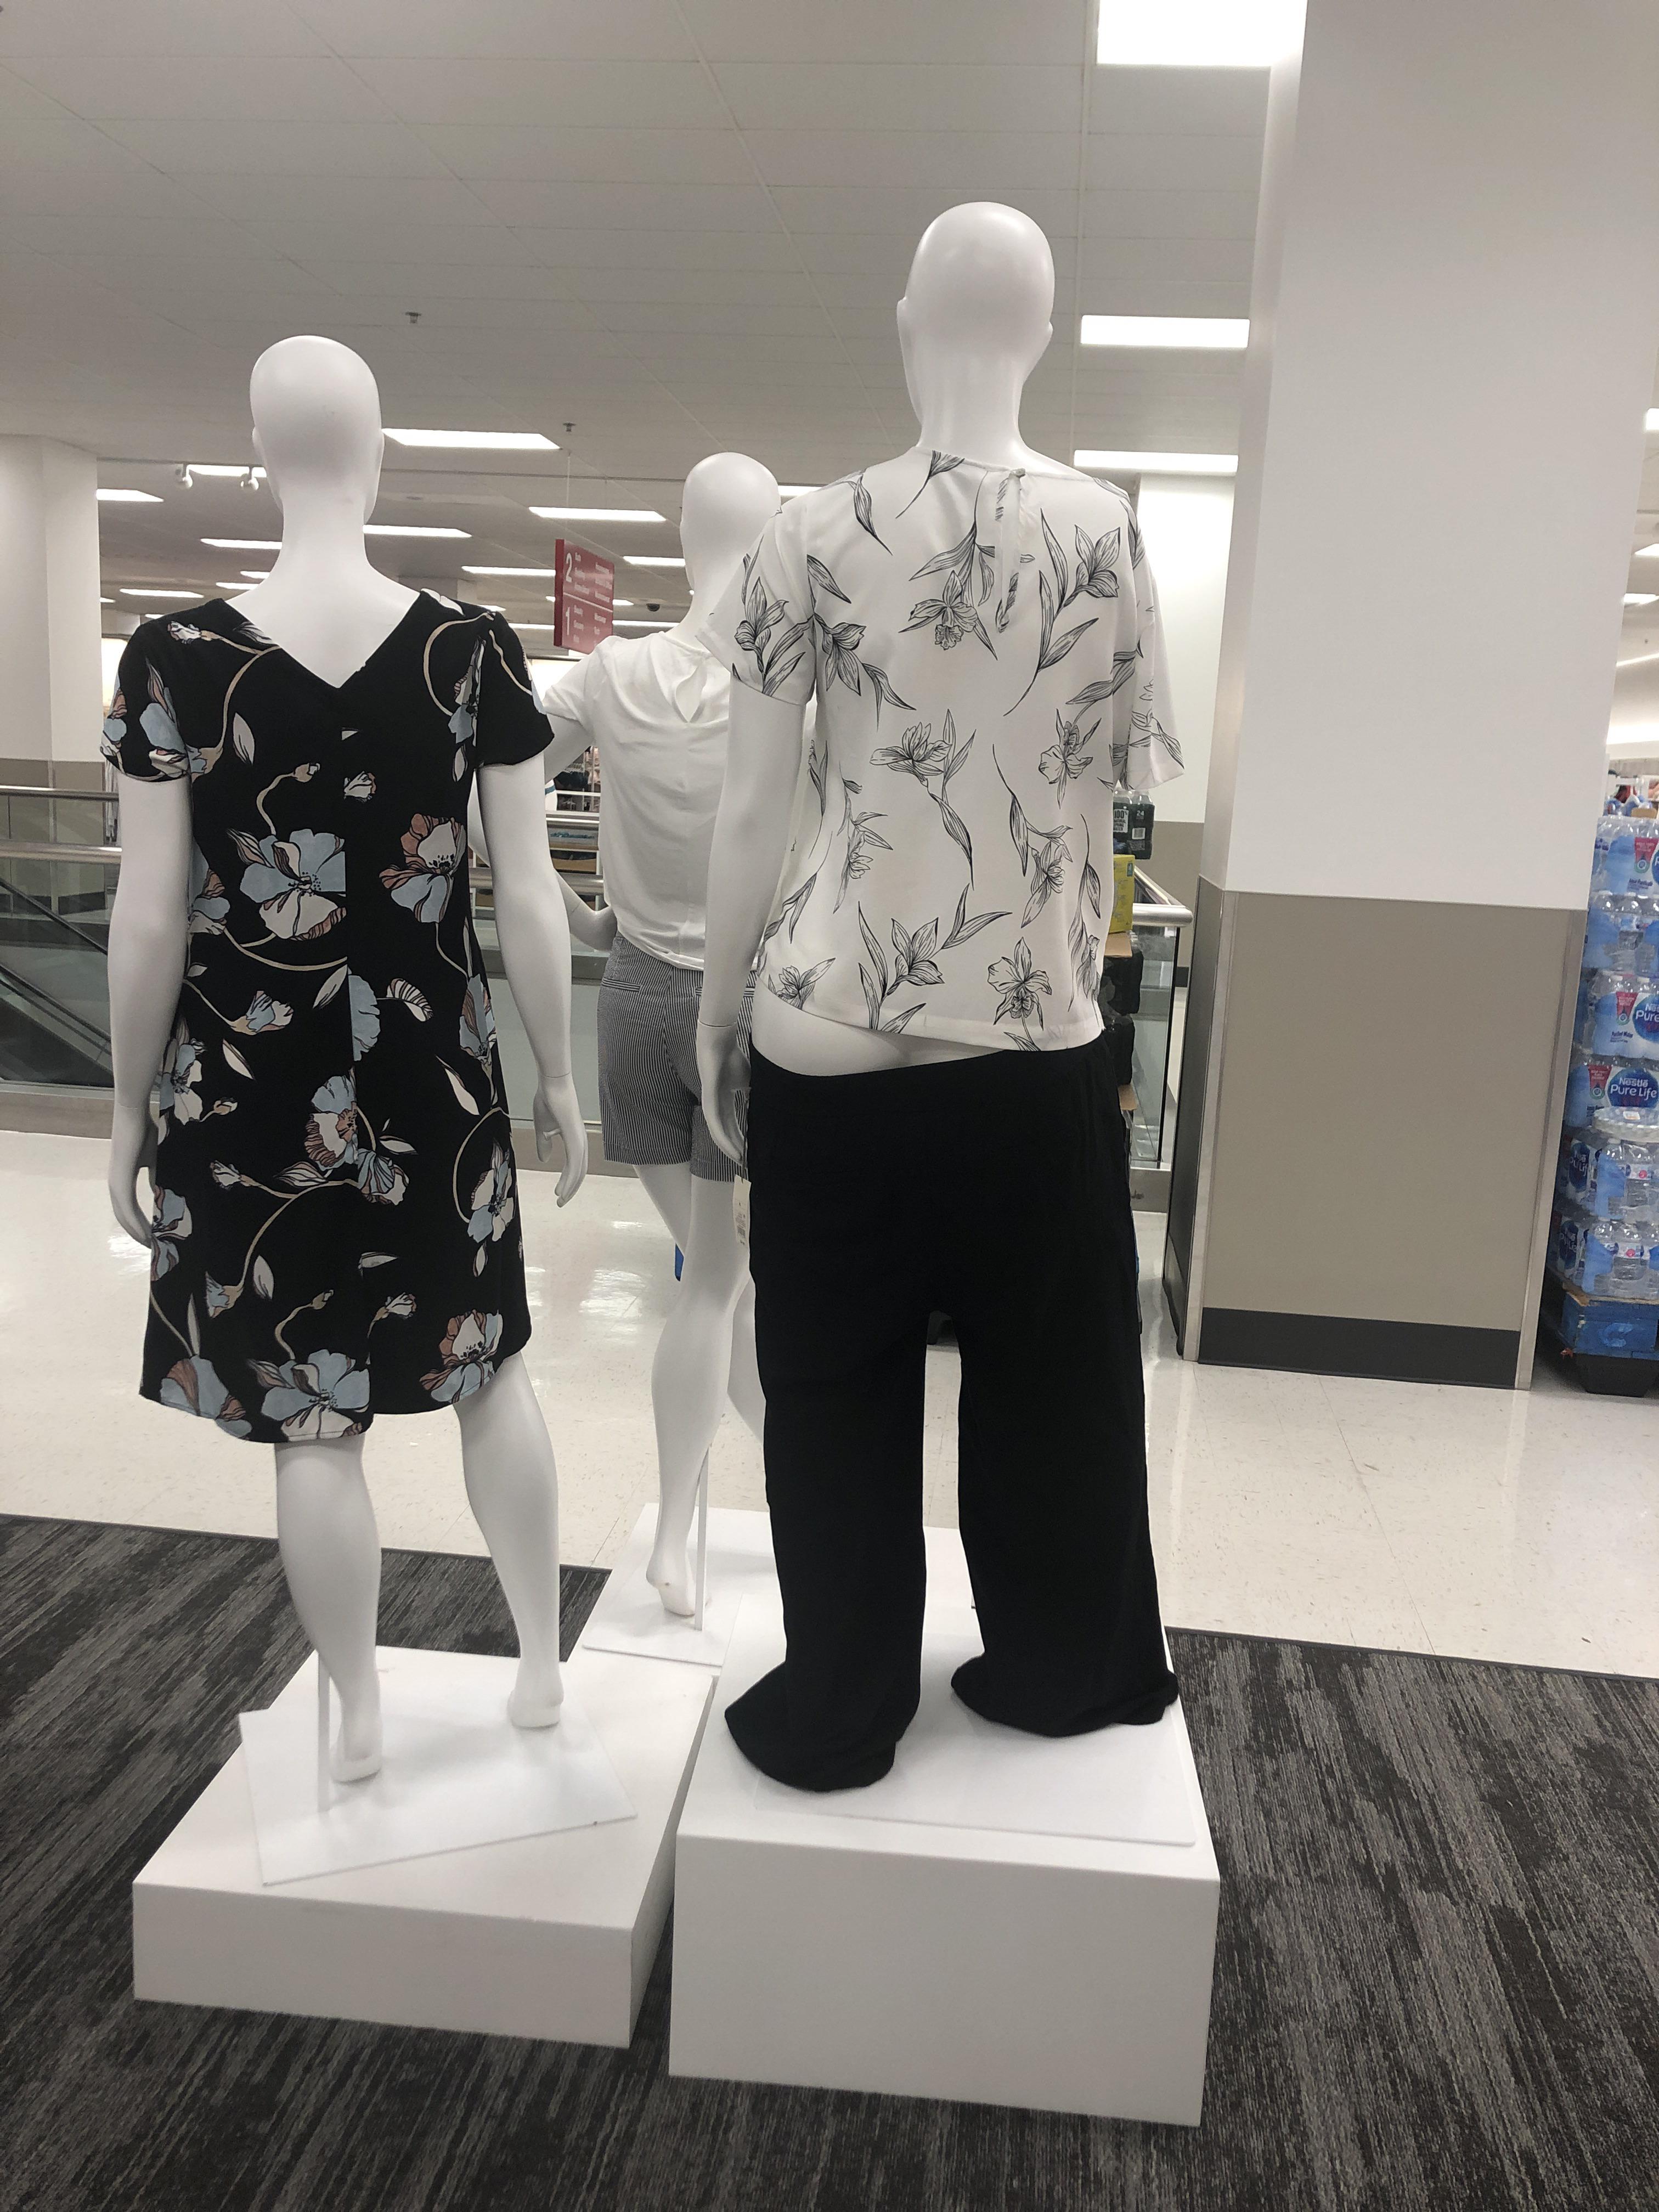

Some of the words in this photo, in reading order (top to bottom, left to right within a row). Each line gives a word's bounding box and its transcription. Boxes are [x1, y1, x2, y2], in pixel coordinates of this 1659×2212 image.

[566, 552, 572, 582] 2
[566, 607, 570, 635] 1
[1610, 1084, 1637, 1096] Pure
[1639, 1088, 1657, 1101] Life
